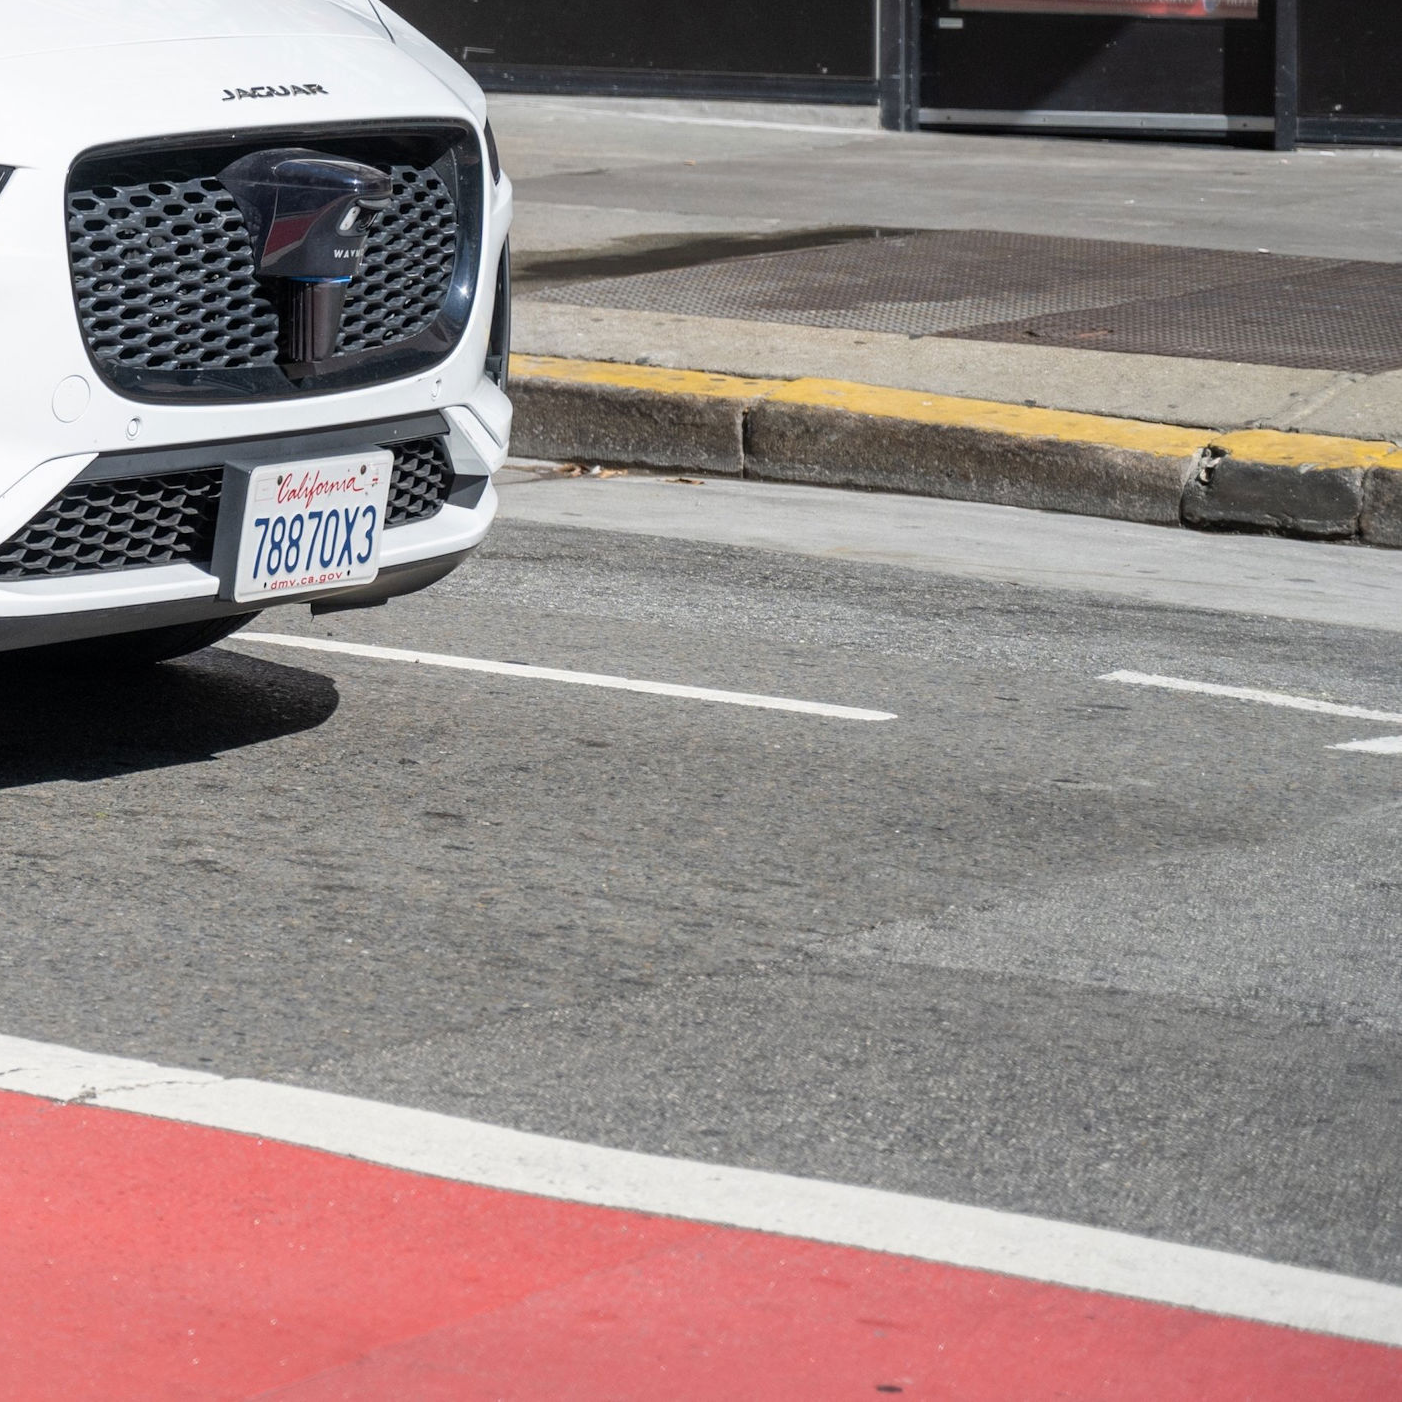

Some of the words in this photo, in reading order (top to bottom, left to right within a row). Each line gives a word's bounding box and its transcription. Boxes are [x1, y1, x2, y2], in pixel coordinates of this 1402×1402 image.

[221, 83, 330, 102] JAGUAR
[277, 470, 364, 509] California
[252, 505, 378, 580] 78870X3
[270, 571, 343, 591] dmv.ca.gov
